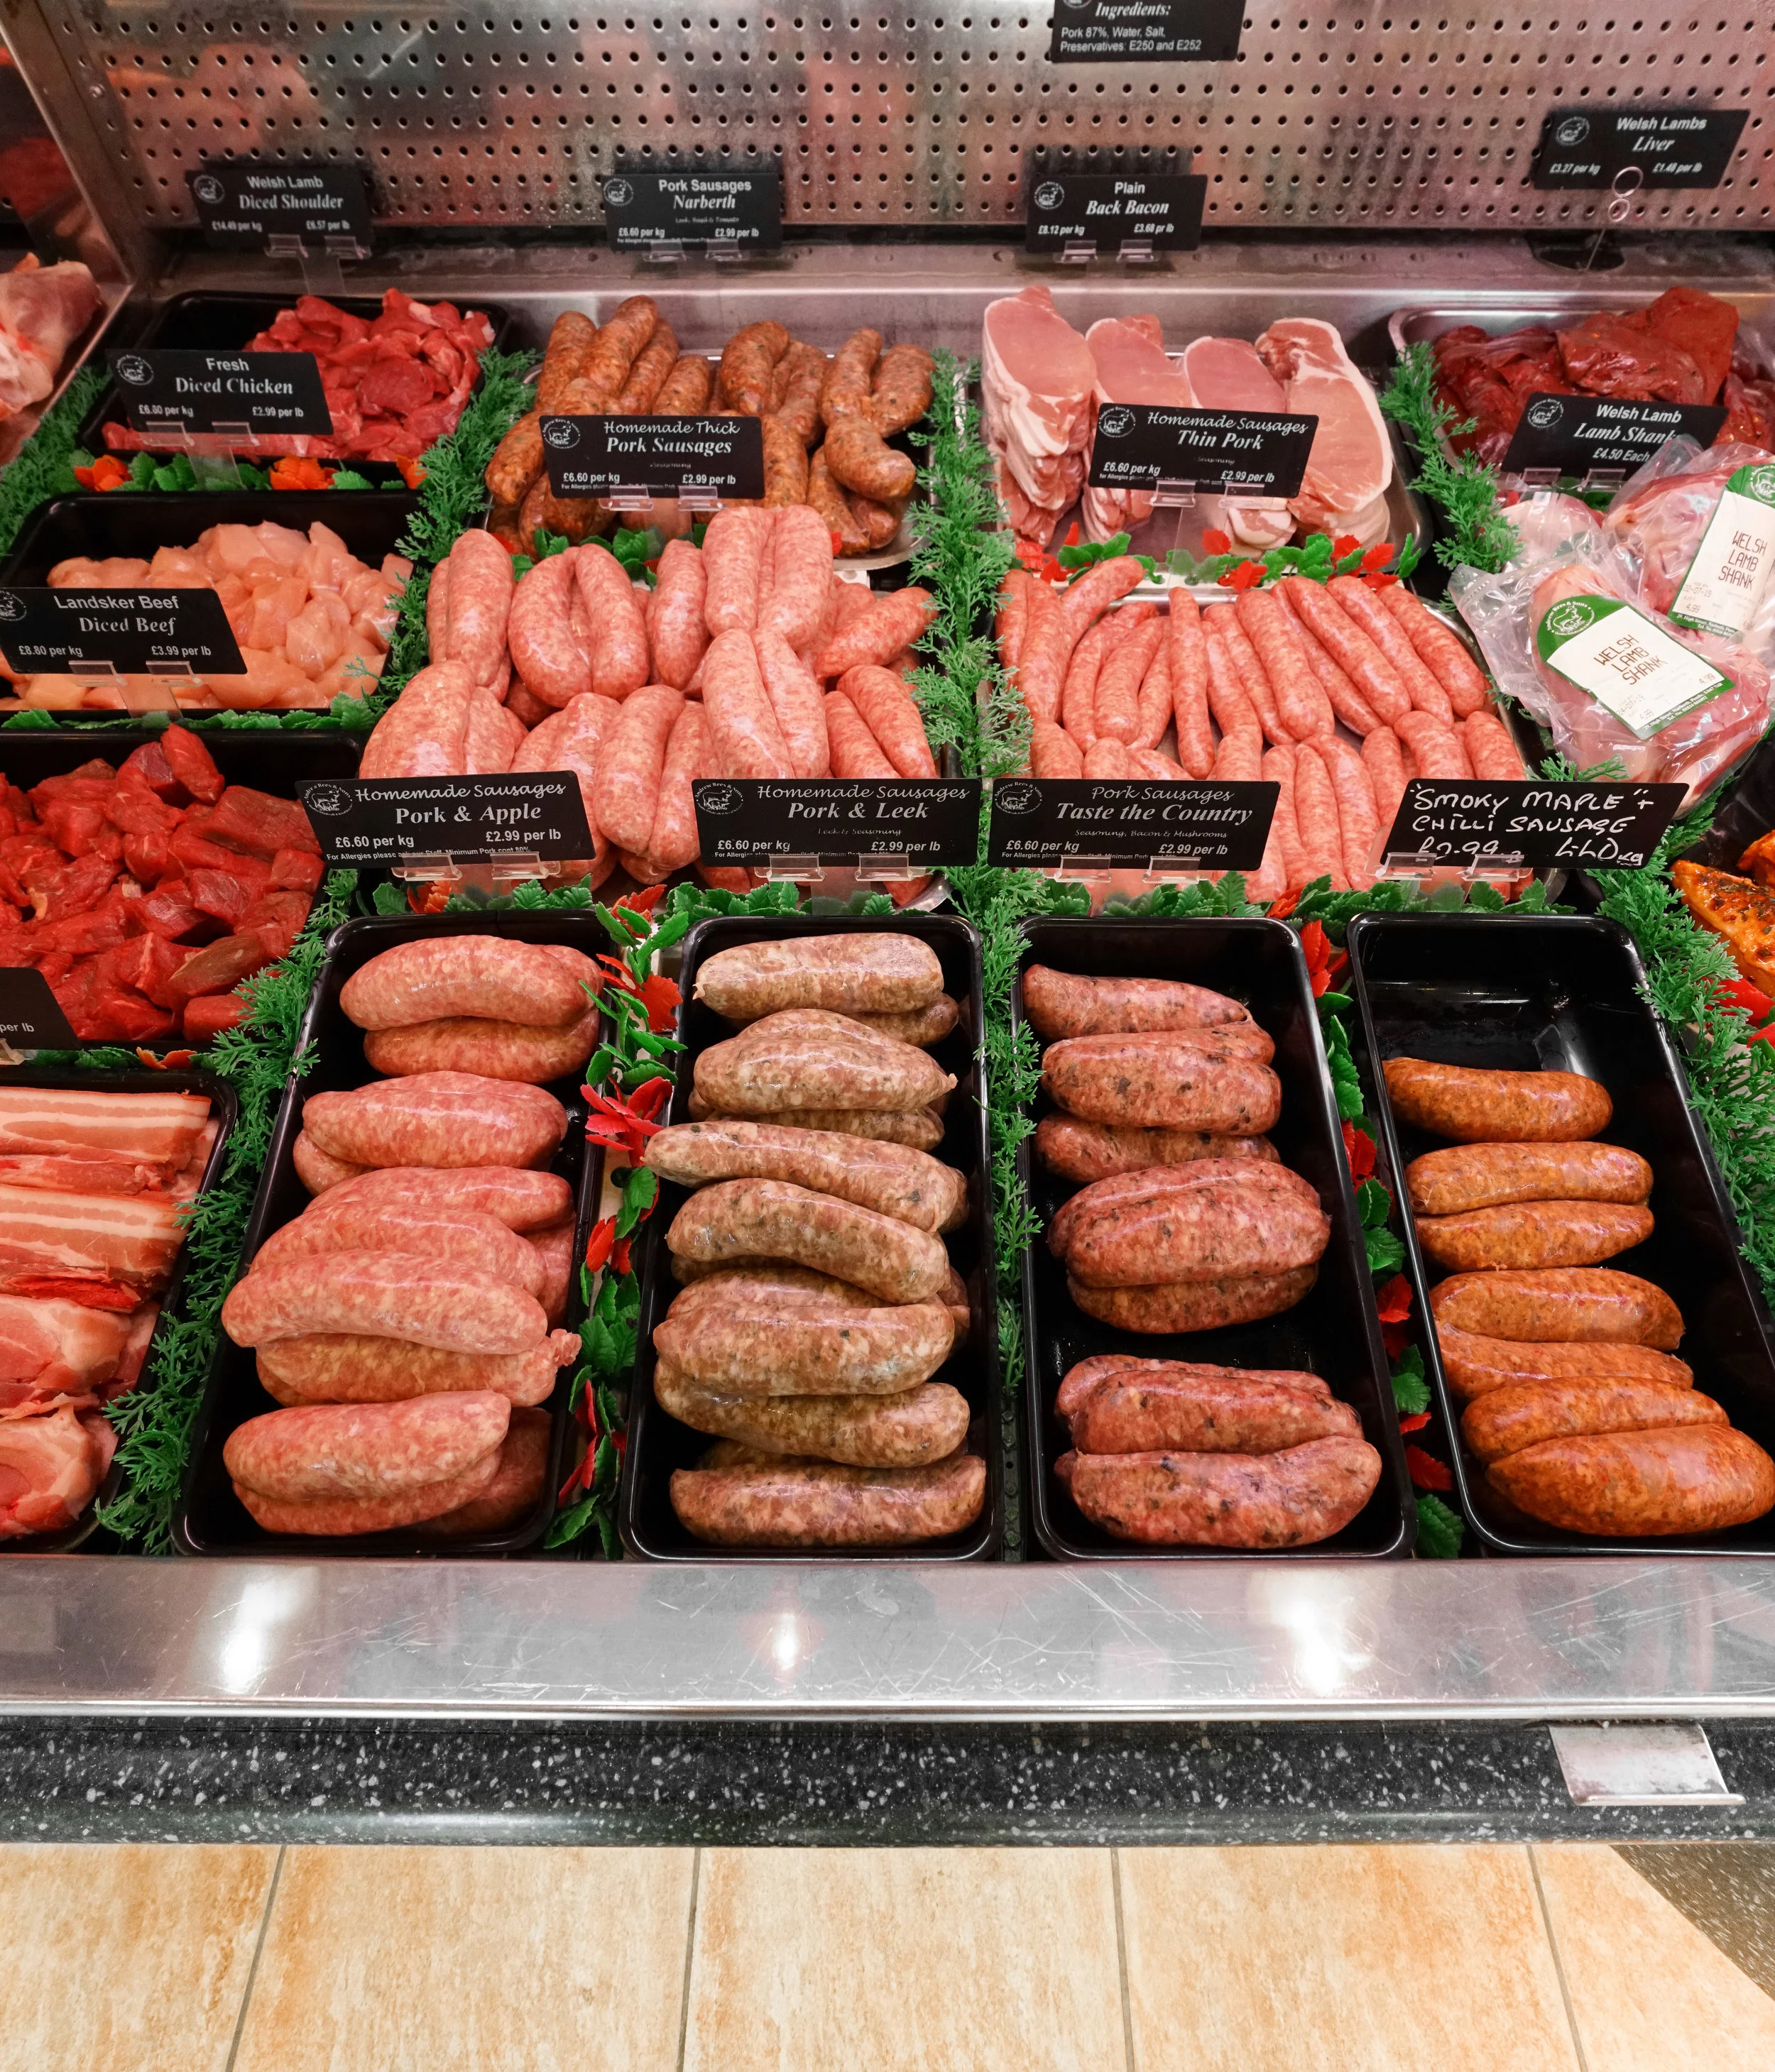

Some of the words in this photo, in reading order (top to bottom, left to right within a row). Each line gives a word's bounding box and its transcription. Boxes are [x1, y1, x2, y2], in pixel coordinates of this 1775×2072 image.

[1096, 3, 1170, 20] Ingredients:
[1061, 28, 1083, 38] Pork
[1060, 41, 1126, 53] Preservatives:
[1130, 40, 1153, 50] E250
[1156, 40, 1173, 50] and
[1176, 40, 1201, 50] E252
[1617, 117, 1656, 131] Welsh
[1660, 116, 1707, 130] Lambs
[1632, 136, 1675, 152] Liver
[1573, 165, 1588, 175] per
[1588, 164, 1601, 175] kg
[1675, 165, 1691, 175] per
[246, 176, 285, 189] Welsh
[288, 176, 323, 188] Lamb
[658, 179, 687, 192] Pork
[692, 180, 752, 193] Sausages
[1115, 182, 1145, 194] Plain
[239, 194, 278, 209] Diced
[282, 194, 344, 209] Shoulder
[674, 194, 736, 209] Narberth
[1086, 200, 1121, 214] Back
[1125, 200, 1169, 214] Bacon
[238, 221, 251, 231] per
[327, 221, 340, 231] per
[619, 228, 638, 236] £6.60
[640, 229, 654, 238] per
[655, 228, 665, 238] kg
[1060, 226, 1074, 236] per
[1074, 226, 1085, 236] kg
[715, 229, 735, 237] £2.99
[737, 229, 750, 238] per
[206, 358, 249, 371] Fresh
[175, 378, 222, 393] Diced
[226, 378, 293, 395] Chicken
[165, 406, 180, 417] per
[182, 405, 193, 417] kg
[253, 407, 275, 416] £2.99
[278, 408, 293, 417] per
[295, 407, 303, 417] lb
[1596, 404, 1639, 420] Welsh
[1642, 407, 1682, 423] Lamb
[604, 422, 694, 434] Homemade
[696, 422, 741, 434] Thick
[1147, 412, 1236, 429] Homemade
[1237, 417, 1308, 436] Sausages
[1573, 422, 1621, 441] Lamb
[606, 437, 647, 453] Pork
[652, 437, 732, 456] Sausages
[1178, 429, 1217, 447] Thin
[1222, 433, 1264, 450] Pork
[1593, 447, 1621, 460] £4.50
[1623, 449, 1650, 461] Each
[1103, 462, 1128, 473] £6.60
[1130, 464, 1146, 476] per
[1149, 465, 1160, 476] kg
[564, 473, 588, 482] £6.60
[591, 473, 606, 484] per
[608, 473, 620, 484] kg
[682, 474, 707, 483] £2.99
[709, 476, 724, 486] per
[727, 475, 736, 484] lb
[1220, 470, 1245, 480] £2.99
[1246, 473, 1265, 483] per
[1267, 472, 1275, 482] lb
[1732, 531, 1768, 556] WELSH
[1728, 549, 1759, 571] LAMB
[1718, 566, 1755, 591] SHANK
[54, 596, 134, 609] Landsker
[138, 596, 180, 609] Beef
[80, 617, 129, 632] Diced
[136, 618, 176, 635] Beef
[19, 646, 46, 656] £8.80
[49, 647, 66, 657] per
[69, 646, 82, 657] kg
[152, 646, 178, 656] £3.99
[182, 647, 199, 657] per
[201, 646, 212, 656] lb
[1594, 635, 1639, 665] WELSH
[1611, 647, 1649, 672] LAMB
[1622, 655, 1668, 685] SHANK
[355, 784, 471, 803] Homemade
[474, 784, 566, 799] Sausages
[757, 785, 877, 799] Homemade
[878, 786, 970, 801] Sausages
[1091, 786, 1138, 800] Pork
[1141, 787, 1235, 804] Sausages
[395, 806, 447, 824] Pork
[454, 806, 472, 822] &
[479, 804, 542, 825] Apple
[788, 803, 841, 818] Pork
[849, 803, 865, 818] &
[876, 802, 929, 818] Leek
[1056, 803, 1117, 820] Taste
[1122, 803, 1154, 819] the
[1162, 804, 1253, 826] Country
[335, 835, 370, 848] £6.60
[373, 837, 395, 850] per
[398, 835, 415, 849] kg
[486, 831, 520, 843] £2.99
[524, 832, 546, 844] per
[549, 829, 561, 841] lb
[718, 840, 749, 850] £6.60
[753, 841, 772, 853] per
[775, 840, 790, 852] kg
[871, 841, 902, 851] £2.99
[905, 842, 926, 853] per
[929, 841, 940, 851] lb
[1006, 840, 1039, 850] £6.60
[1041, 842, 1064, 853] per
[1064, 840, 1079, 853] kg
[1159, 844, 1191, 854] £2.99
[1193, 845, 1213, 857] per
[1216, 845, 1228, 855] lb
[0, 1024, 18, 1033] per
[22, 1023, 34, 1032] lb
